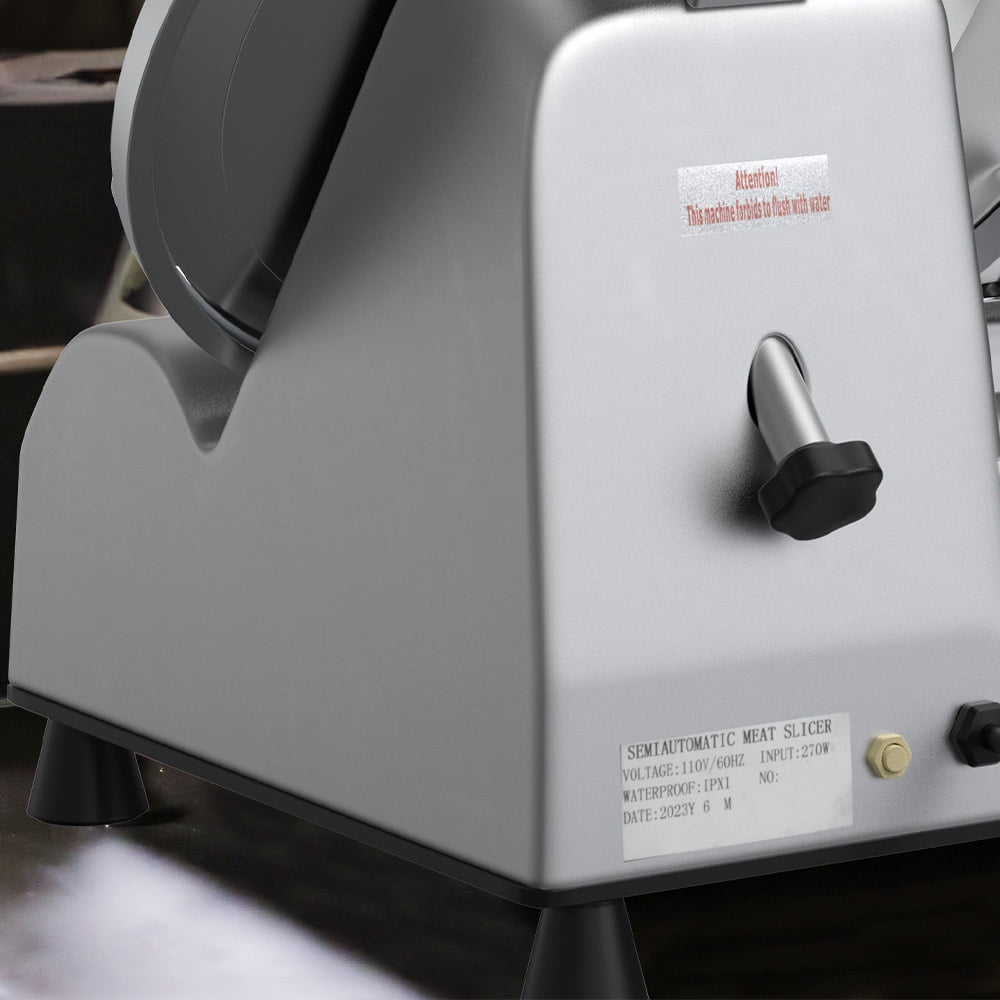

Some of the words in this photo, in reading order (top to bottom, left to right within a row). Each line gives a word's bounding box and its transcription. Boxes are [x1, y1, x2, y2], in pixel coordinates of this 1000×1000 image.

[735, 166, 779, 191] Attention!
[687, 204, 703, 226] This
[705, 200, 735, 224] machine
[736, 196, 762, 221] forbids
[763, 198, 771, 218] to
[772, 195, 791, 216] flush
[792, 192, 808, 214] with
[810, 192, 830, 213] water
[627, 732, 736, 760] SEMIAUTOMATIC
[743, 727, 776, 744] MEAT
[784, 719, 832, 739] SLICER
[623, 754, 745, 782] VOLTAGE:110V/60HZ
[760, 742, 830, 764] INPUT:270W
[760, 771, 779, 784] NO:
[623, 802, 695, 825] DATE:2023Y
[703, 801, 710, 813] 6
[724, 798, 732, 810] M
